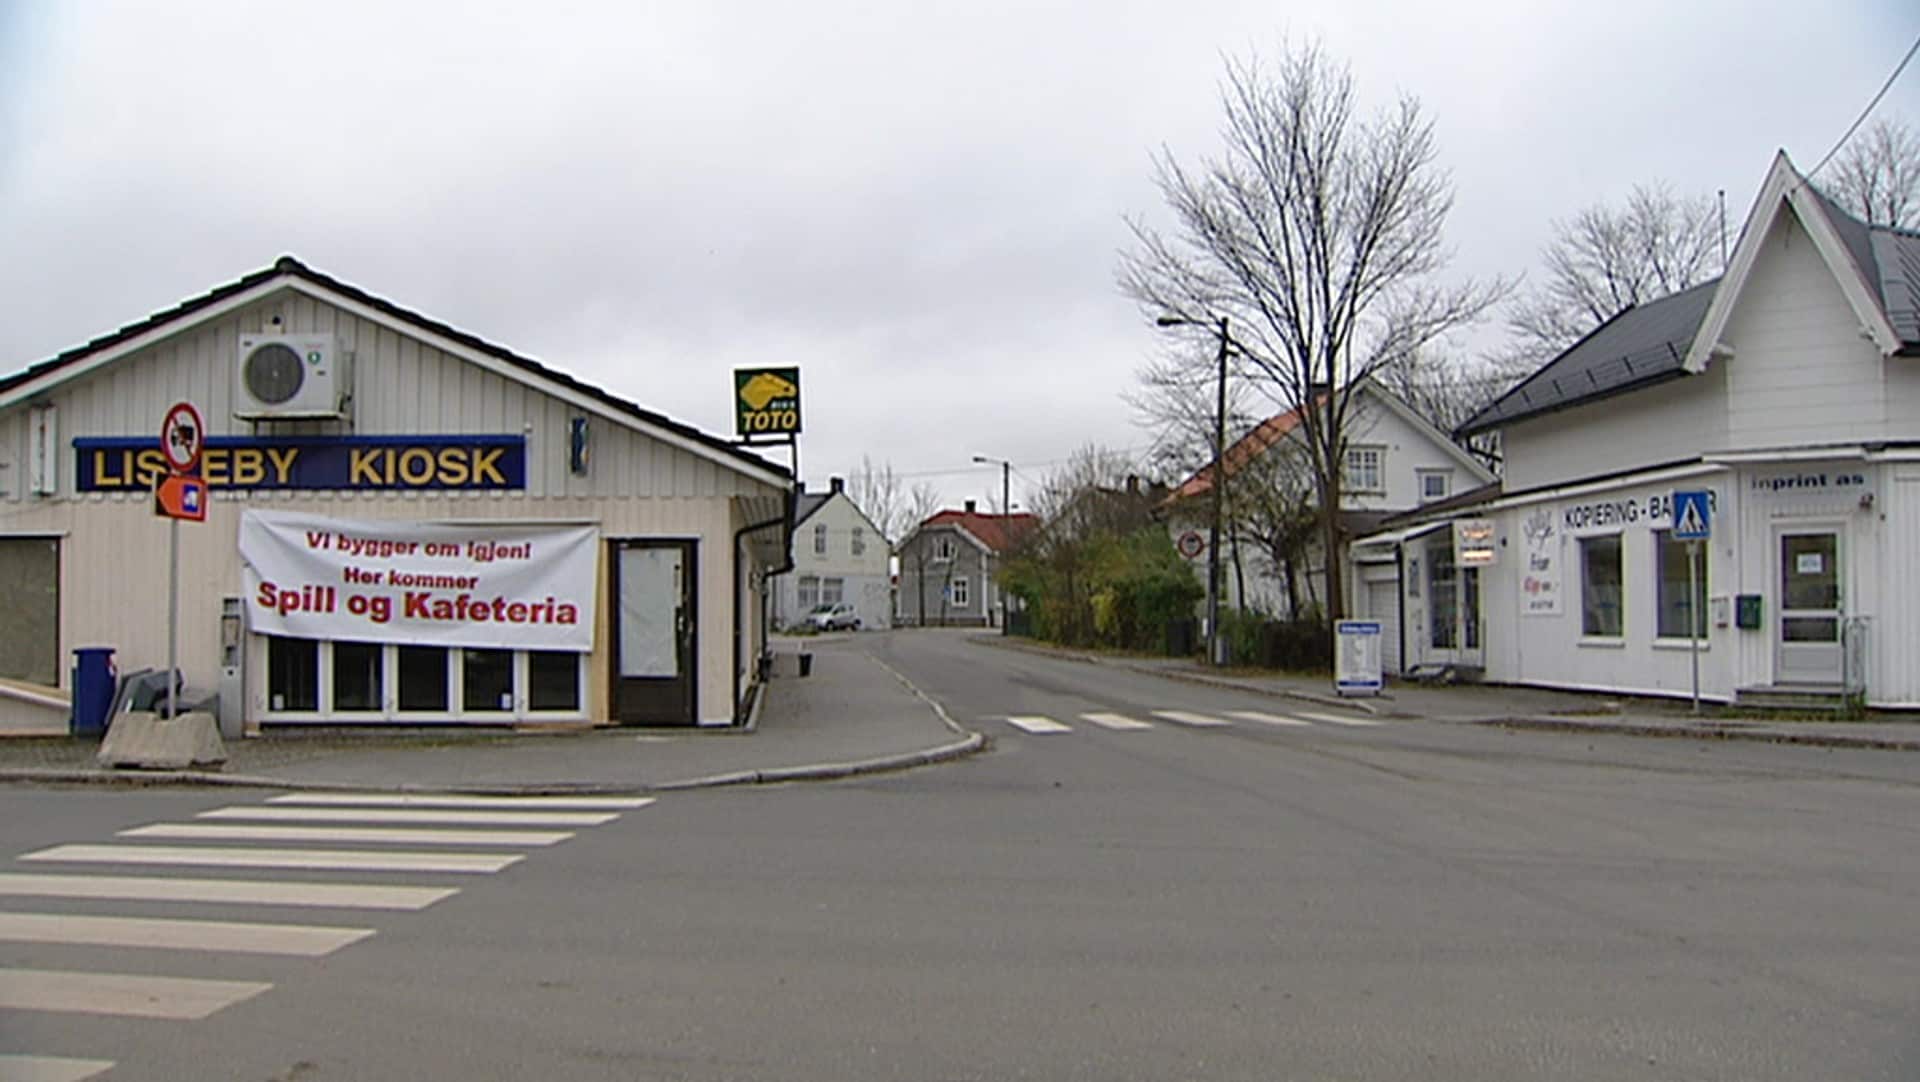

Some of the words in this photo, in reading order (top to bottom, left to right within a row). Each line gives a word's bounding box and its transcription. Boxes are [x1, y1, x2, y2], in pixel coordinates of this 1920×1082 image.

[742, 410, 797, 431] TOTO
[94, 449, 298, 486] LISEBY
[351, 448, 506, 485] KIOSK
[1752, 474, 1827, 491] inprint
[1836, 475, 1864, 486] as
[1565, 499, 1639, 529] KOPIERING
[337, 534, 419, 558] bygger
[424, 542, 460, 557] om
[343, 567, 383, 585] Her
[389, 570, 479, 589] kommer
[257, 581, 336, 616] Spill
[346, 593, 392, 623] og
[404, 592, 578, 624] Kafeteria
